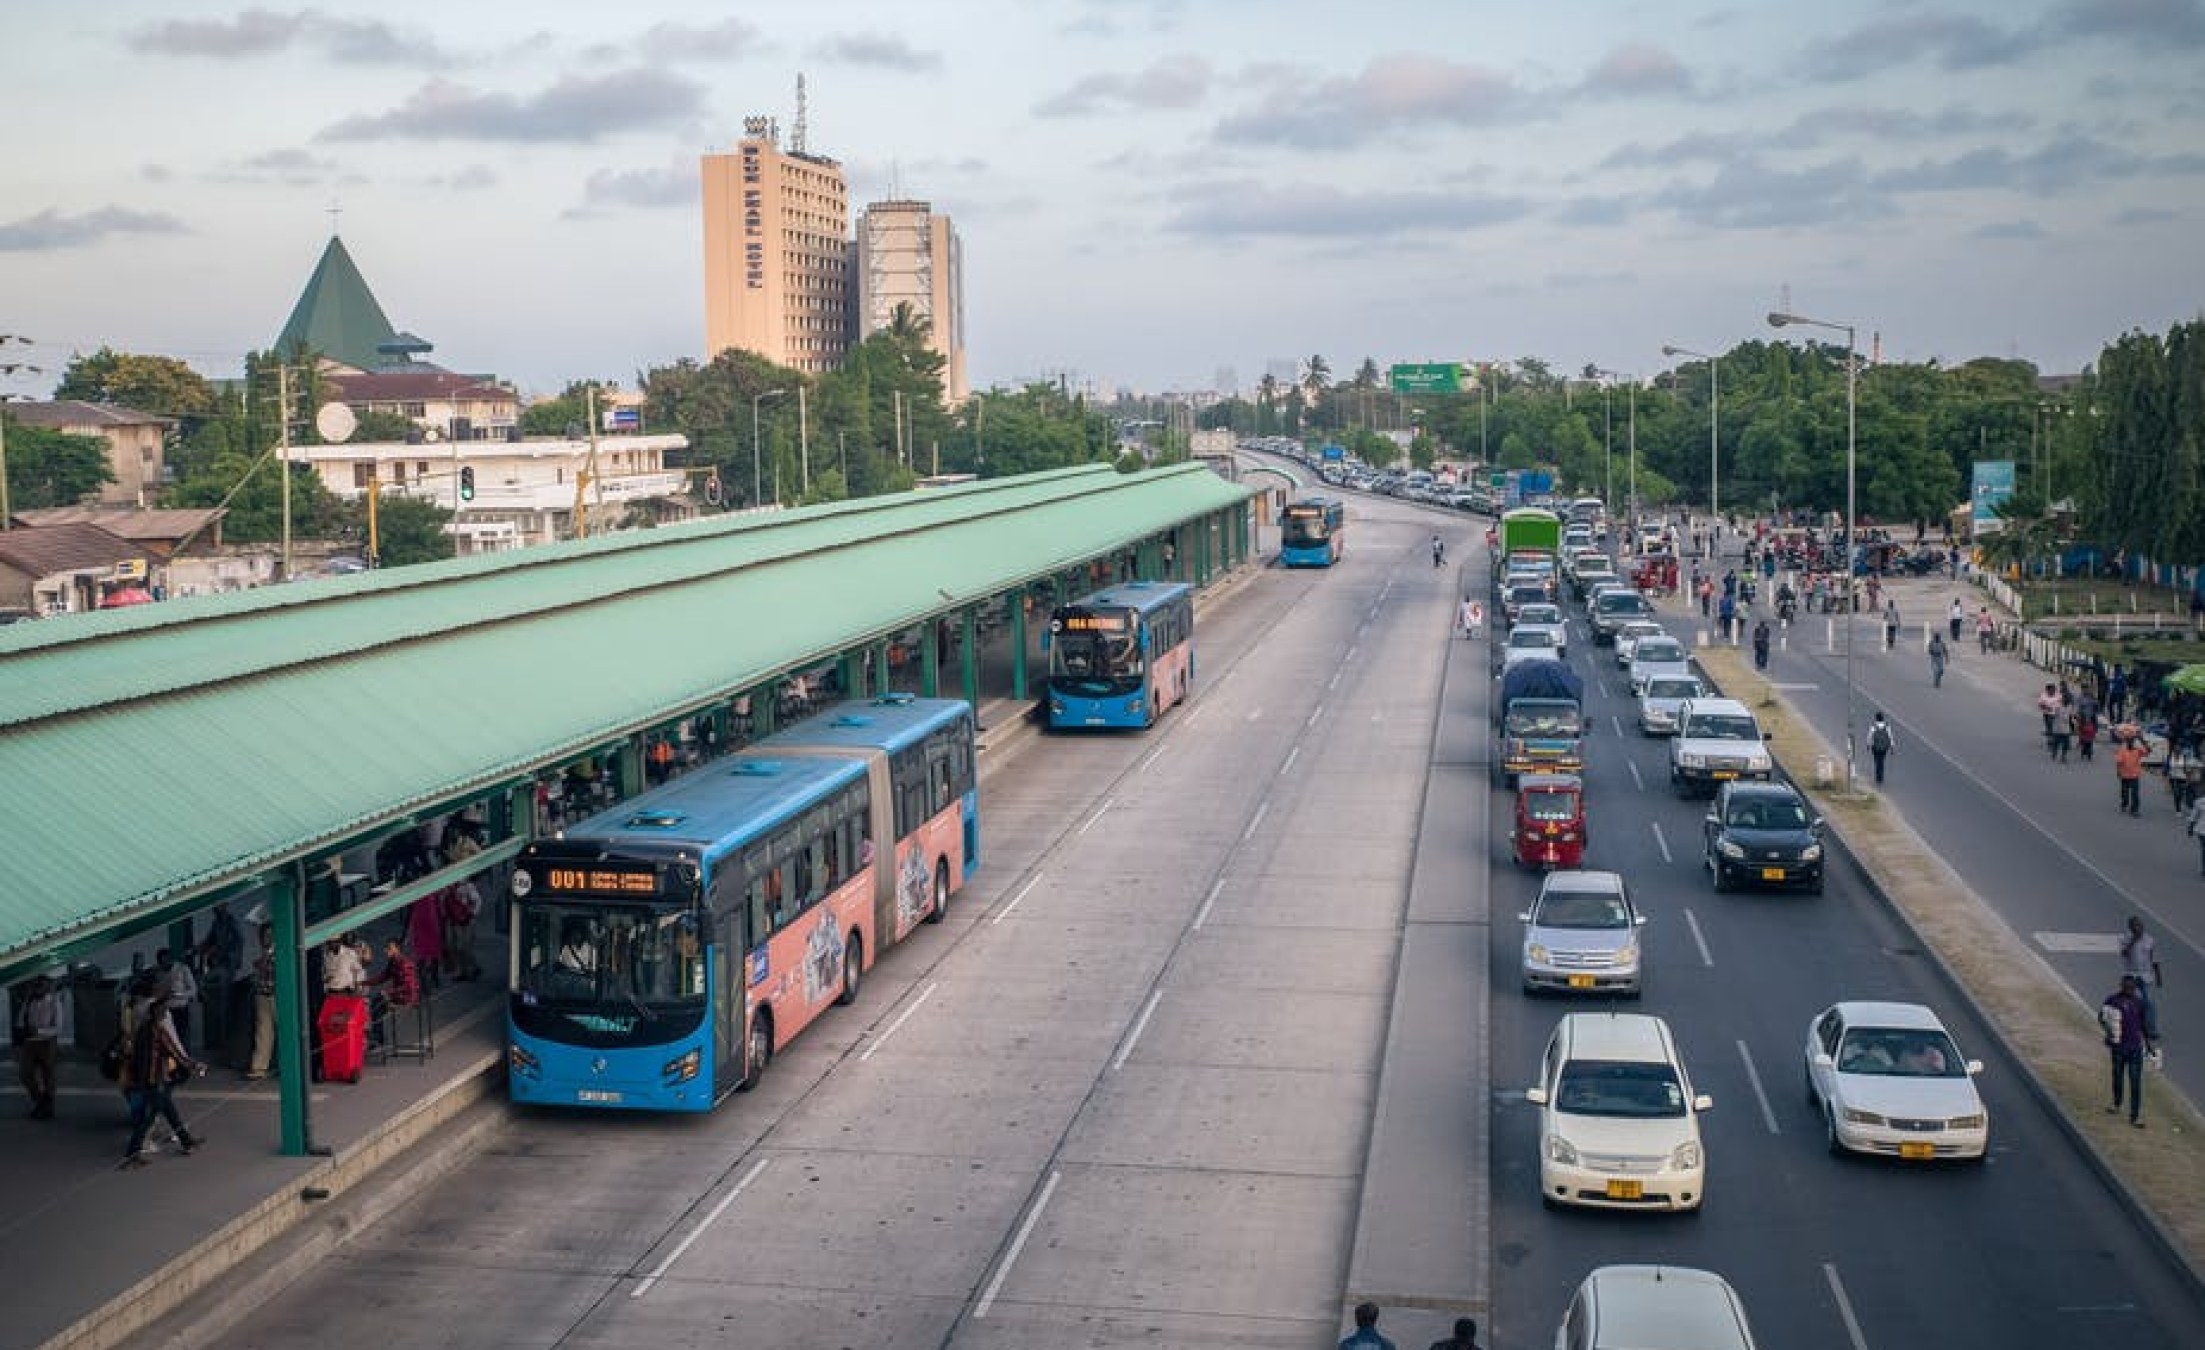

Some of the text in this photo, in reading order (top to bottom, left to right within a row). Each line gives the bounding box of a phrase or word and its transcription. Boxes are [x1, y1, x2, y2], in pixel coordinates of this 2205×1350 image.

[743, 147, 762, 288] BLUE PEARL HOTEL
[551, 870, 585, 889] 001
